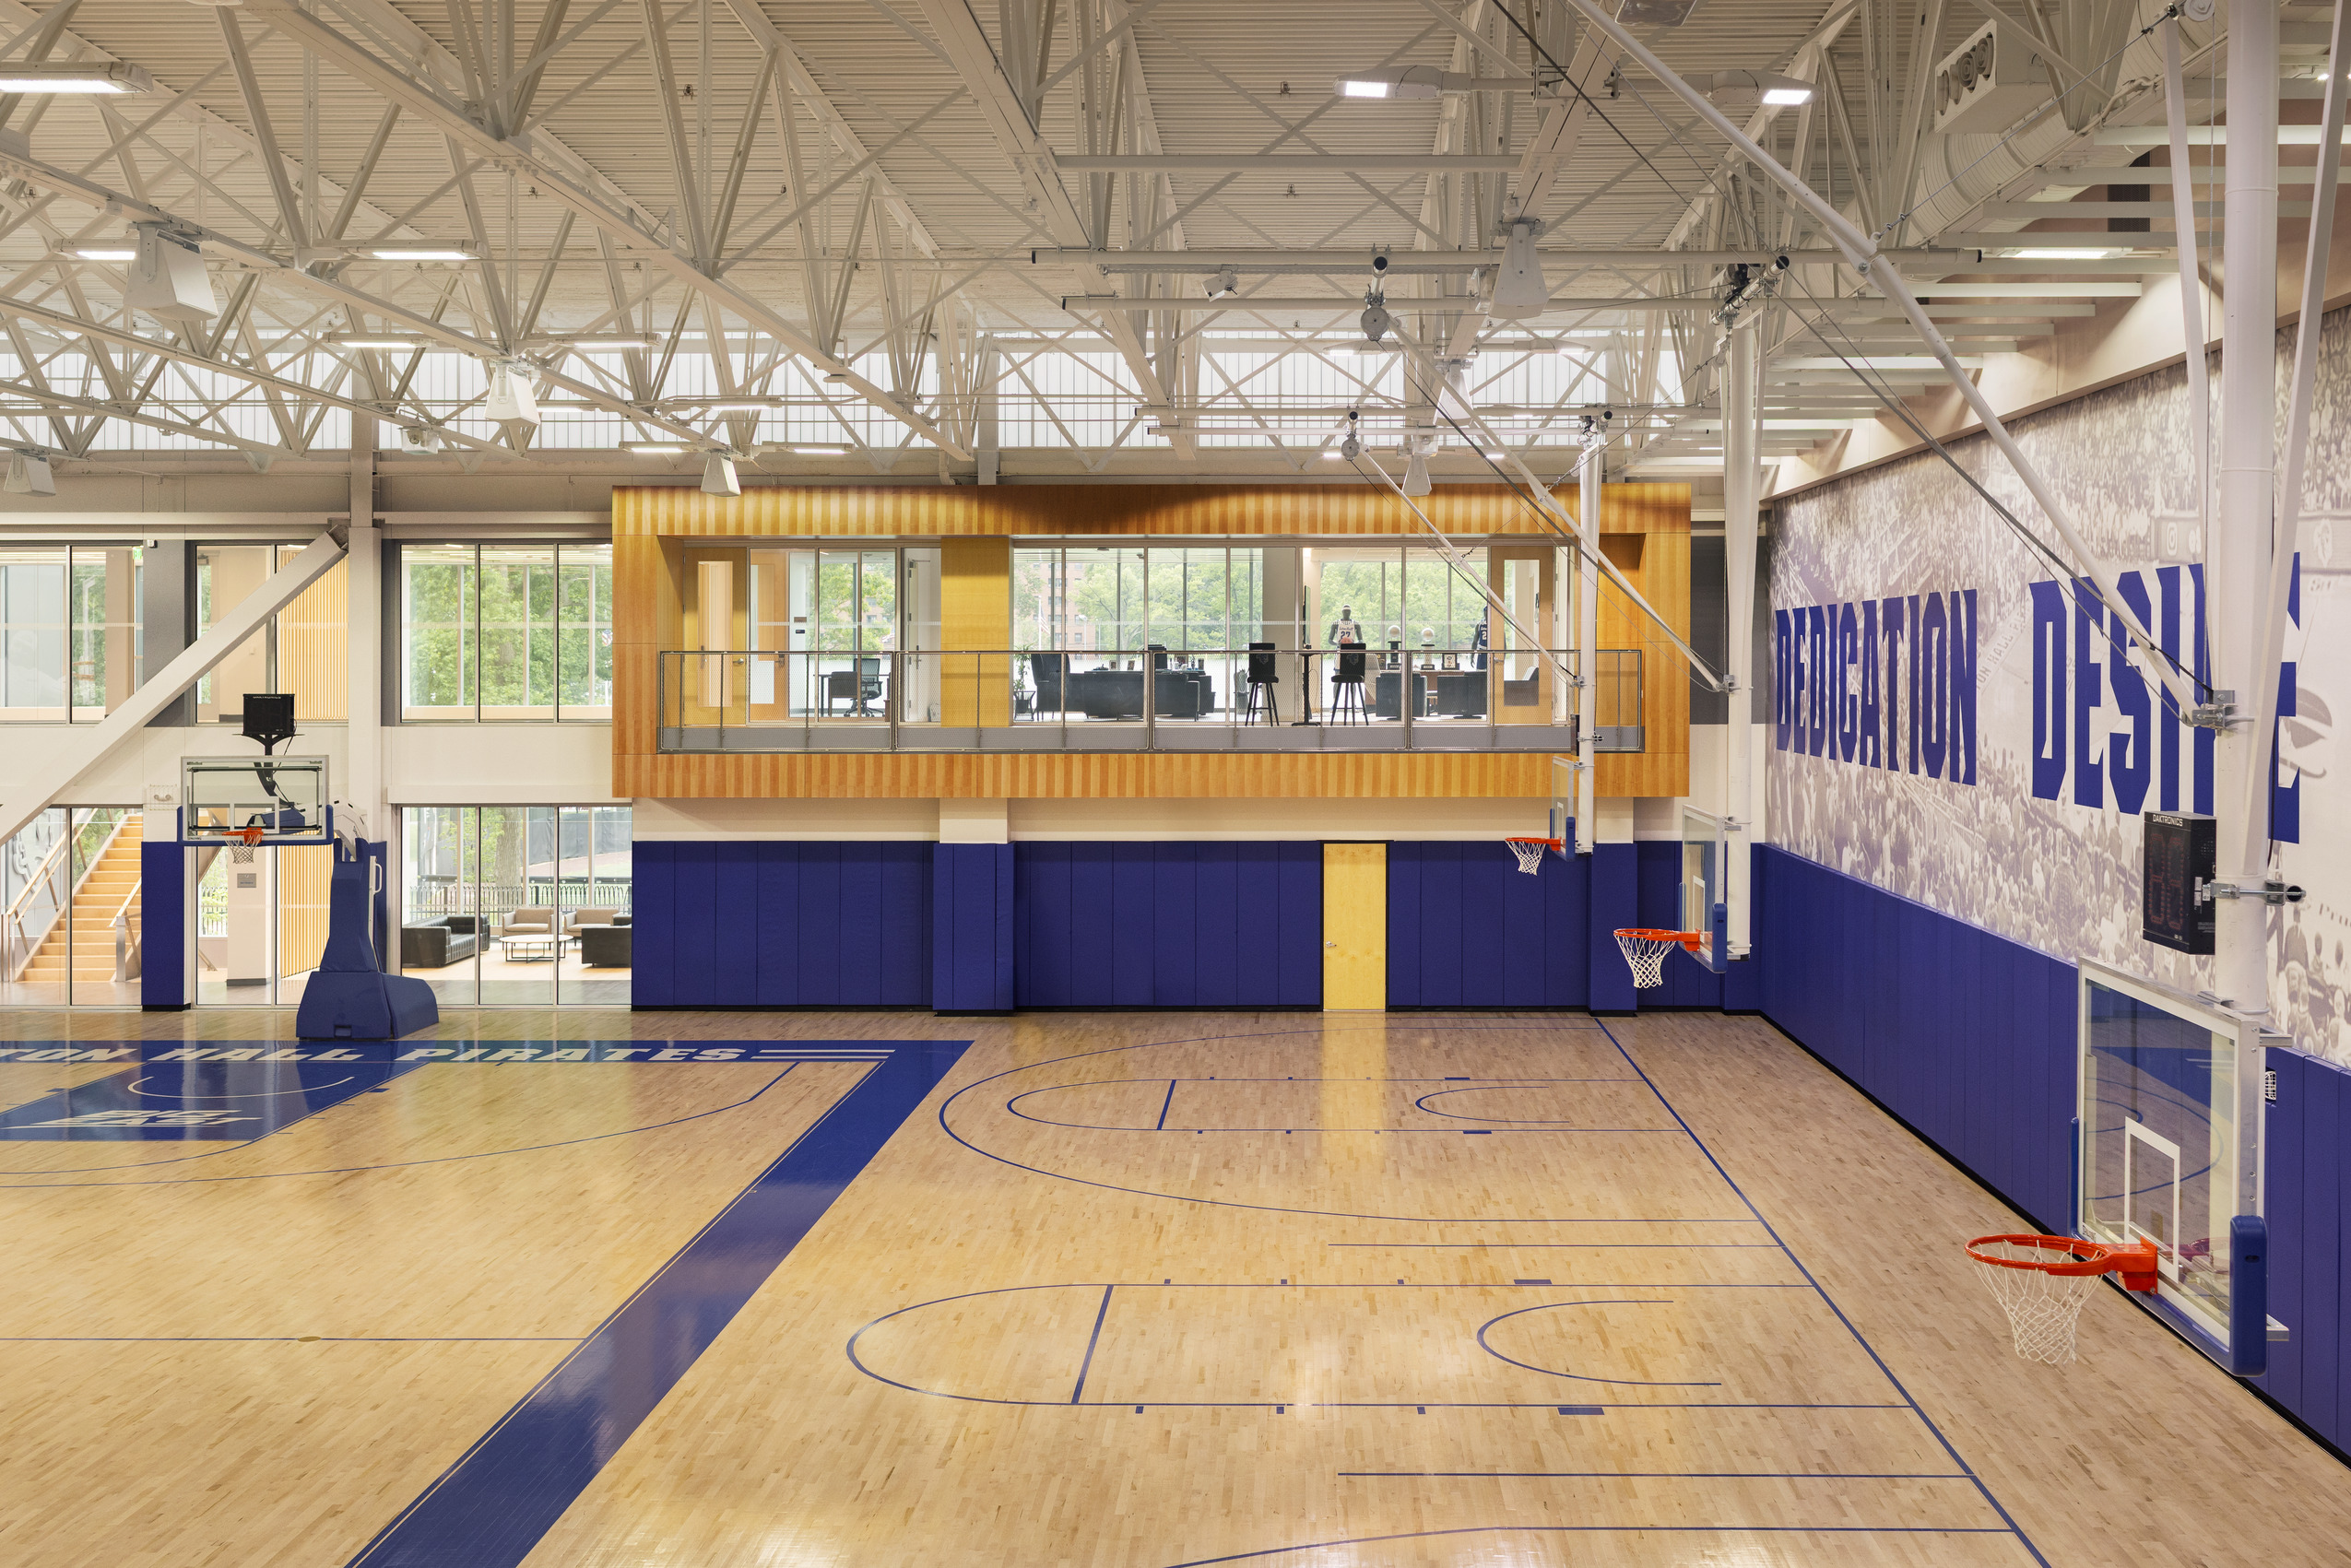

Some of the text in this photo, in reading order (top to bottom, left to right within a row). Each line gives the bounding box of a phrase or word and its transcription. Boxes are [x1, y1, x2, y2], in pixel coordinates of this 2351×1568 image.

[1776, 589, 1977, 786] DEDICATION
[2153, 814, 2183, 827] DAKTRONICS
[148, 1048, 364, 1061] HALL
[394, 1048, 746, 1061] PIRATES
[76, 1110, 242, 1118] BIG
[30, 1117, 263, 1126] EAST
